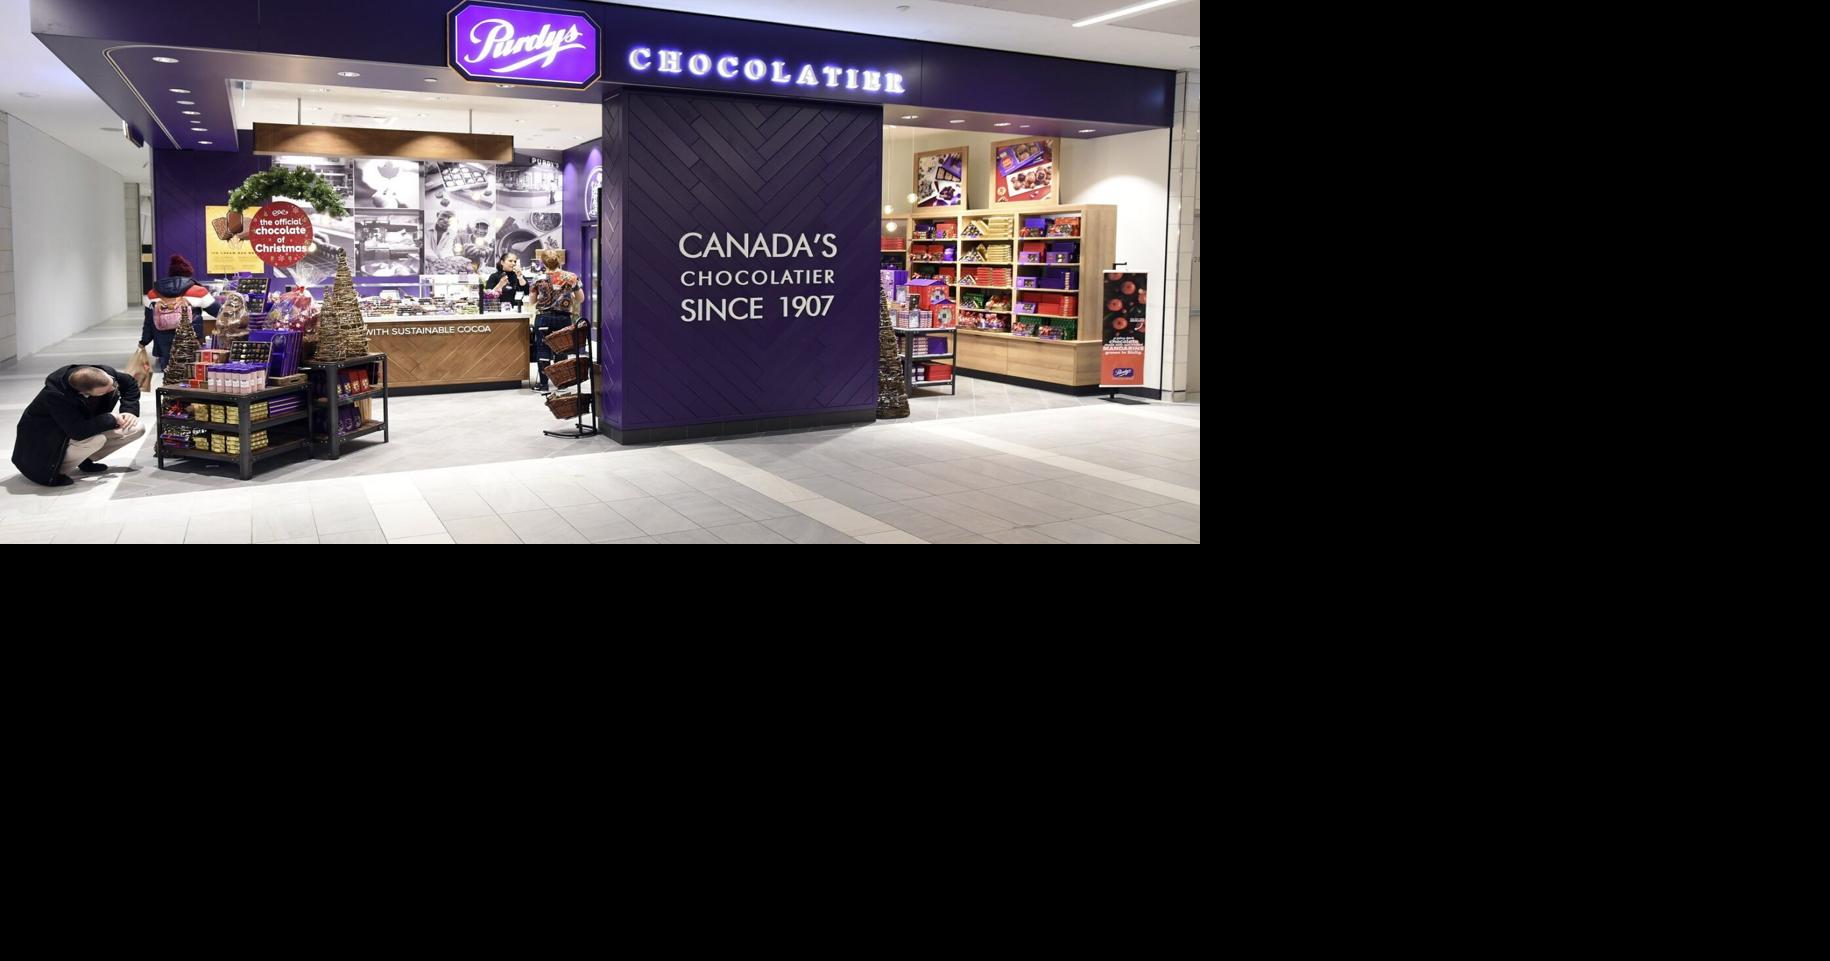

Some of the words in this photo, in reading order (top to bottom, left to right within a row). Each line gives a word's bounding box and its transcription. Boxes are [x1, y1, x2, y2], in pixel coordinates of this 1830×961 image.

[464, 18, 587, 73] Purdys
[628, 47, 906, 93] CHOCOLATIER
[255, 226, 306, 235] chocolate
[274, 218, 302, 226] official
[255, 244, 307, 252] Christmas
[678, 231, 838, 259] CANADA'S
[680, 269, 835, 287] CHOCOLATIER
[680, 297, 764, 323] SINCE
[779, 295, 835, 318] 1907
[366, 328, 389, 336] WITH
[391, 326, 455, 336] SUSTAINABLE
[457, 325, 492, 333] COCOA
